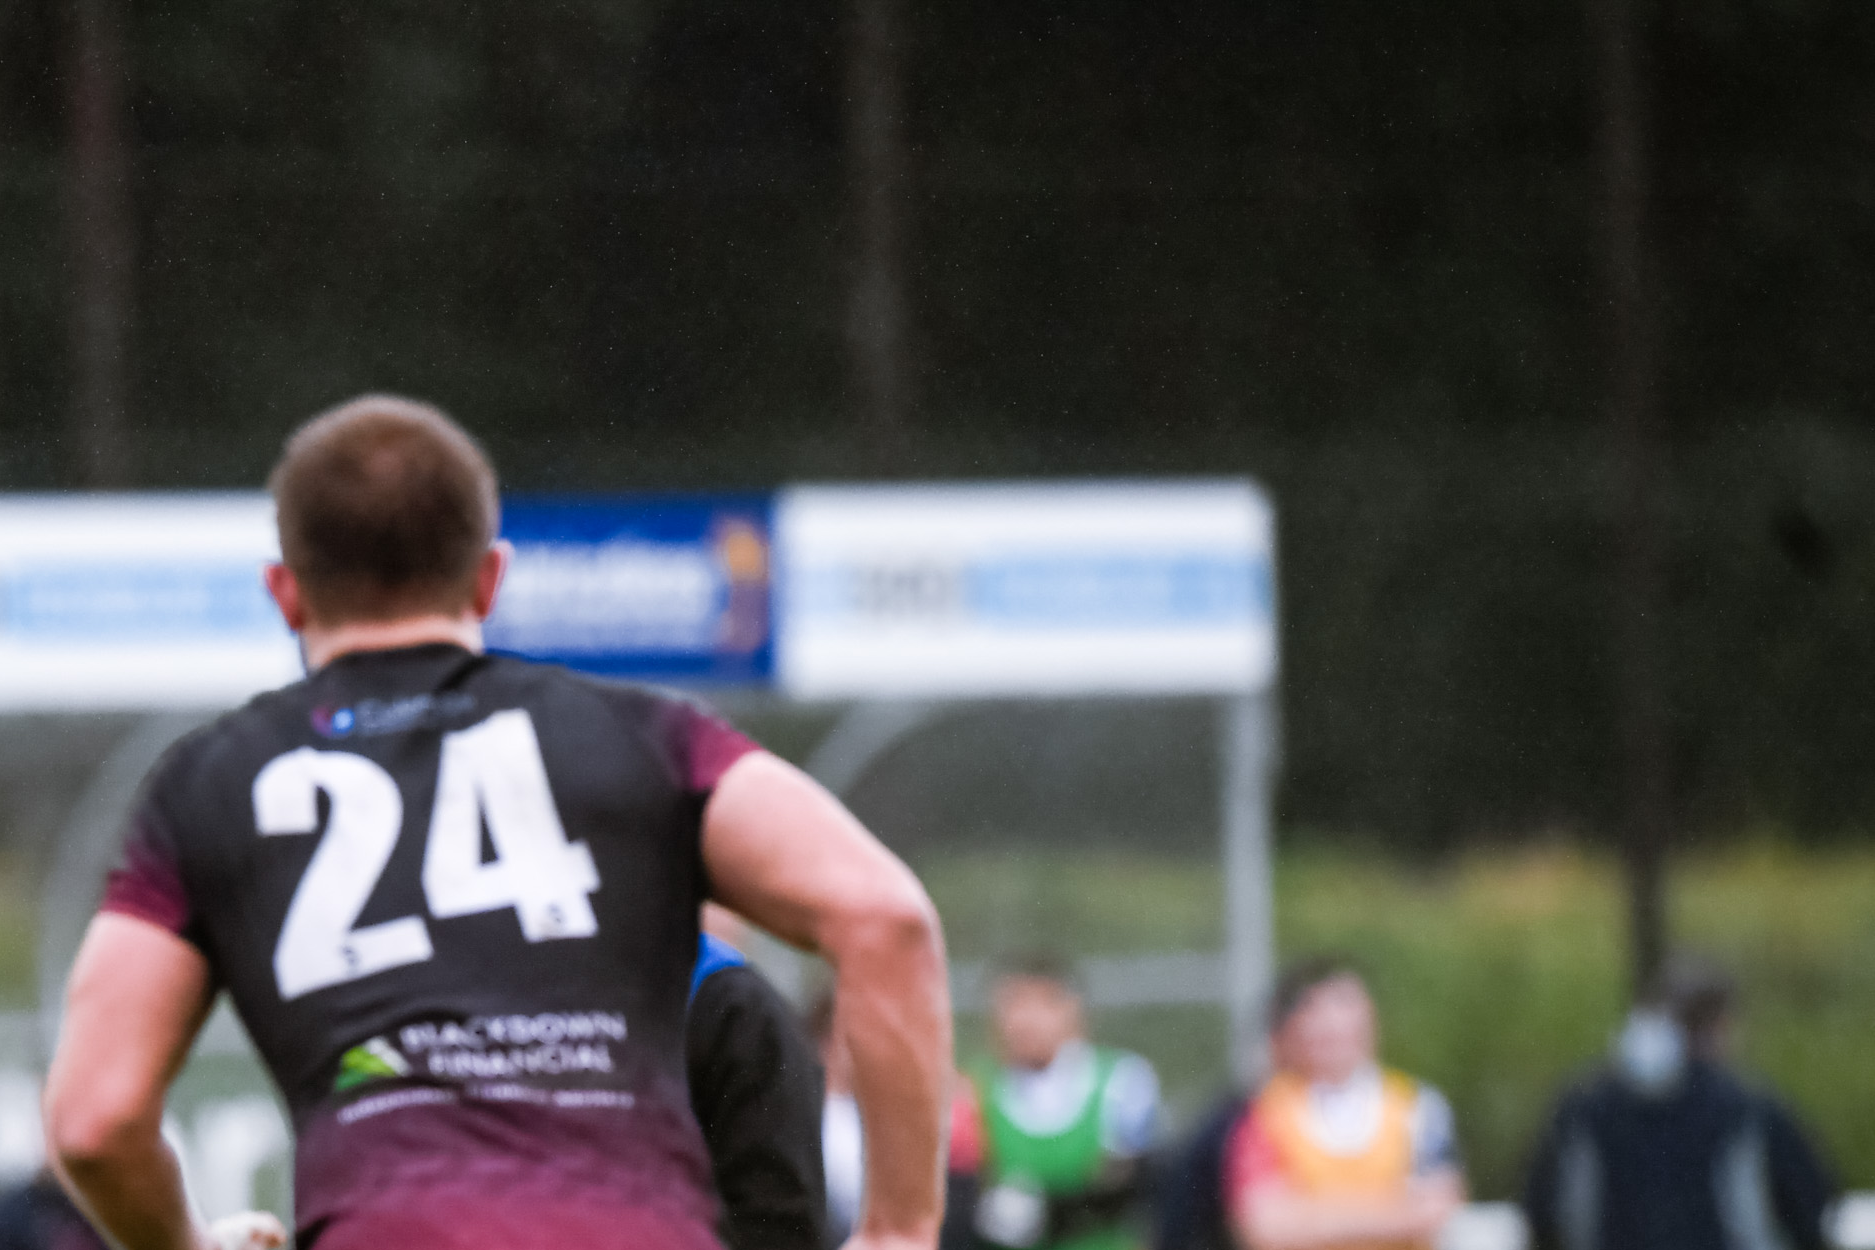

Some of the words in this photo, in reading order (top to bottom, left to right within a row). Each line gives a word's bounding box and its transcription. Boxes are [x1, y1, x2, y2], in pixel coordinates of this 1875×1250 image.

[251, 708, 601, 1001] 24
[400, 1013, 628, 1053] BLACKDOWN
[428, 1045, 613, 1077] FINANCIAL
